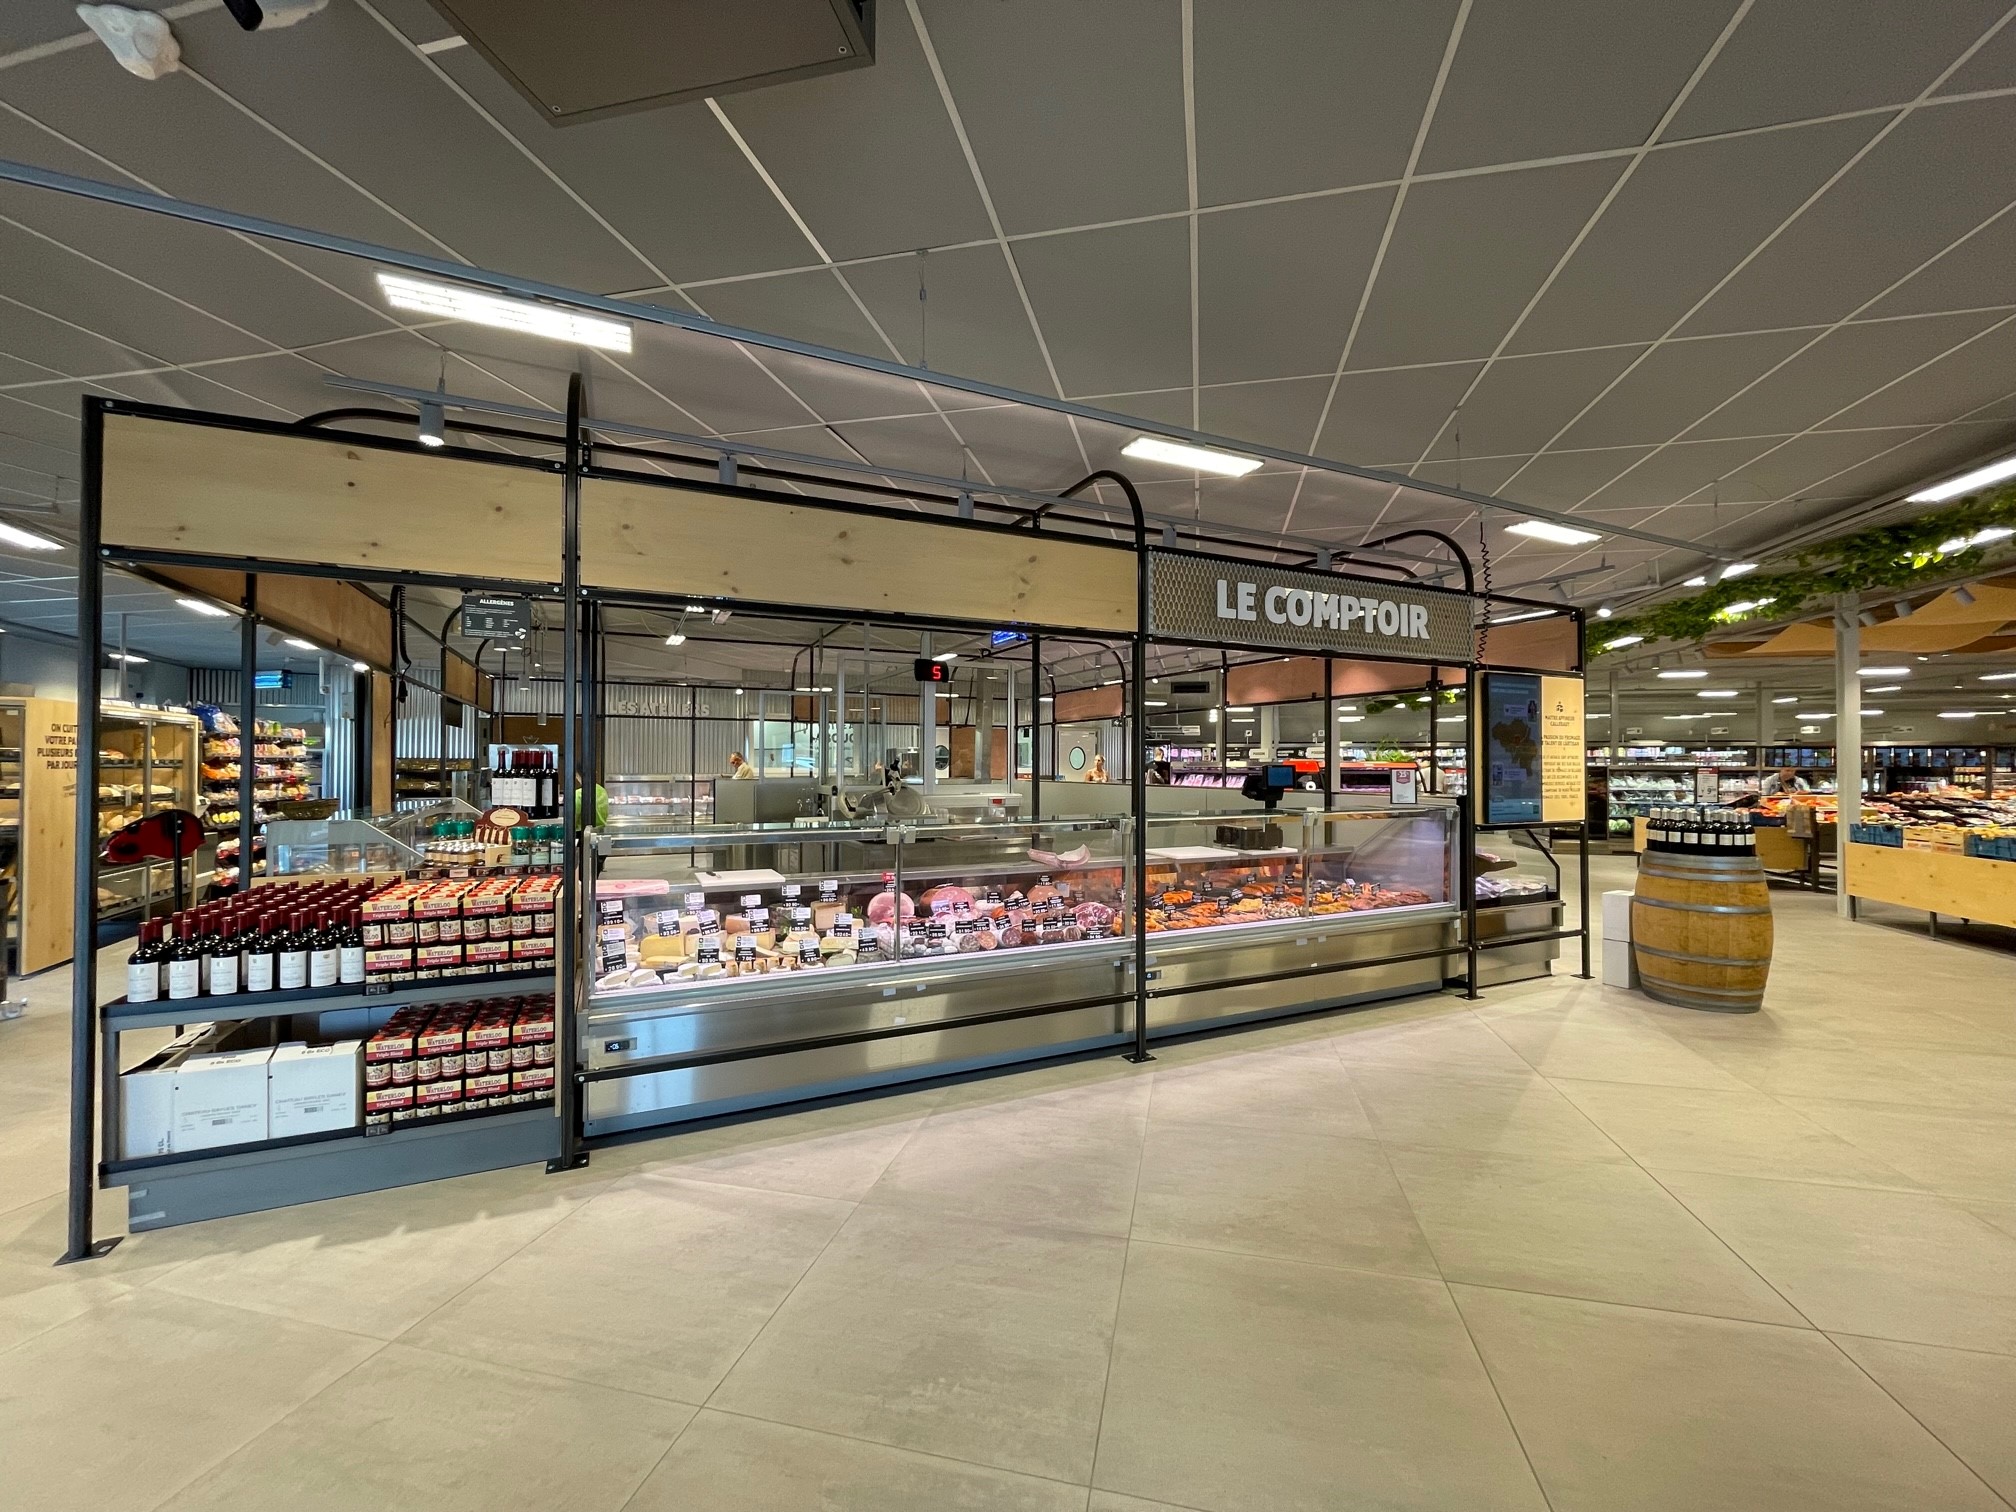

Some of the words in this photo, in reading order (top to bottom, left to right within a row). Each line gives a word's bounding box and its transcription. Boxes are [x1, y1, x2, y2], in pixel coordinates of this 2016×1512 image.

[1217, 580, 1256, 621] LE
[1264, 586, 1430, 640] COMPTOIR
[610, 700, 636, 714] LES
[45, 736, 66, 745] VOTRE
[37, 748, 73, 757] PLUSIEURS
[47, 760, 60, 769] PAR
